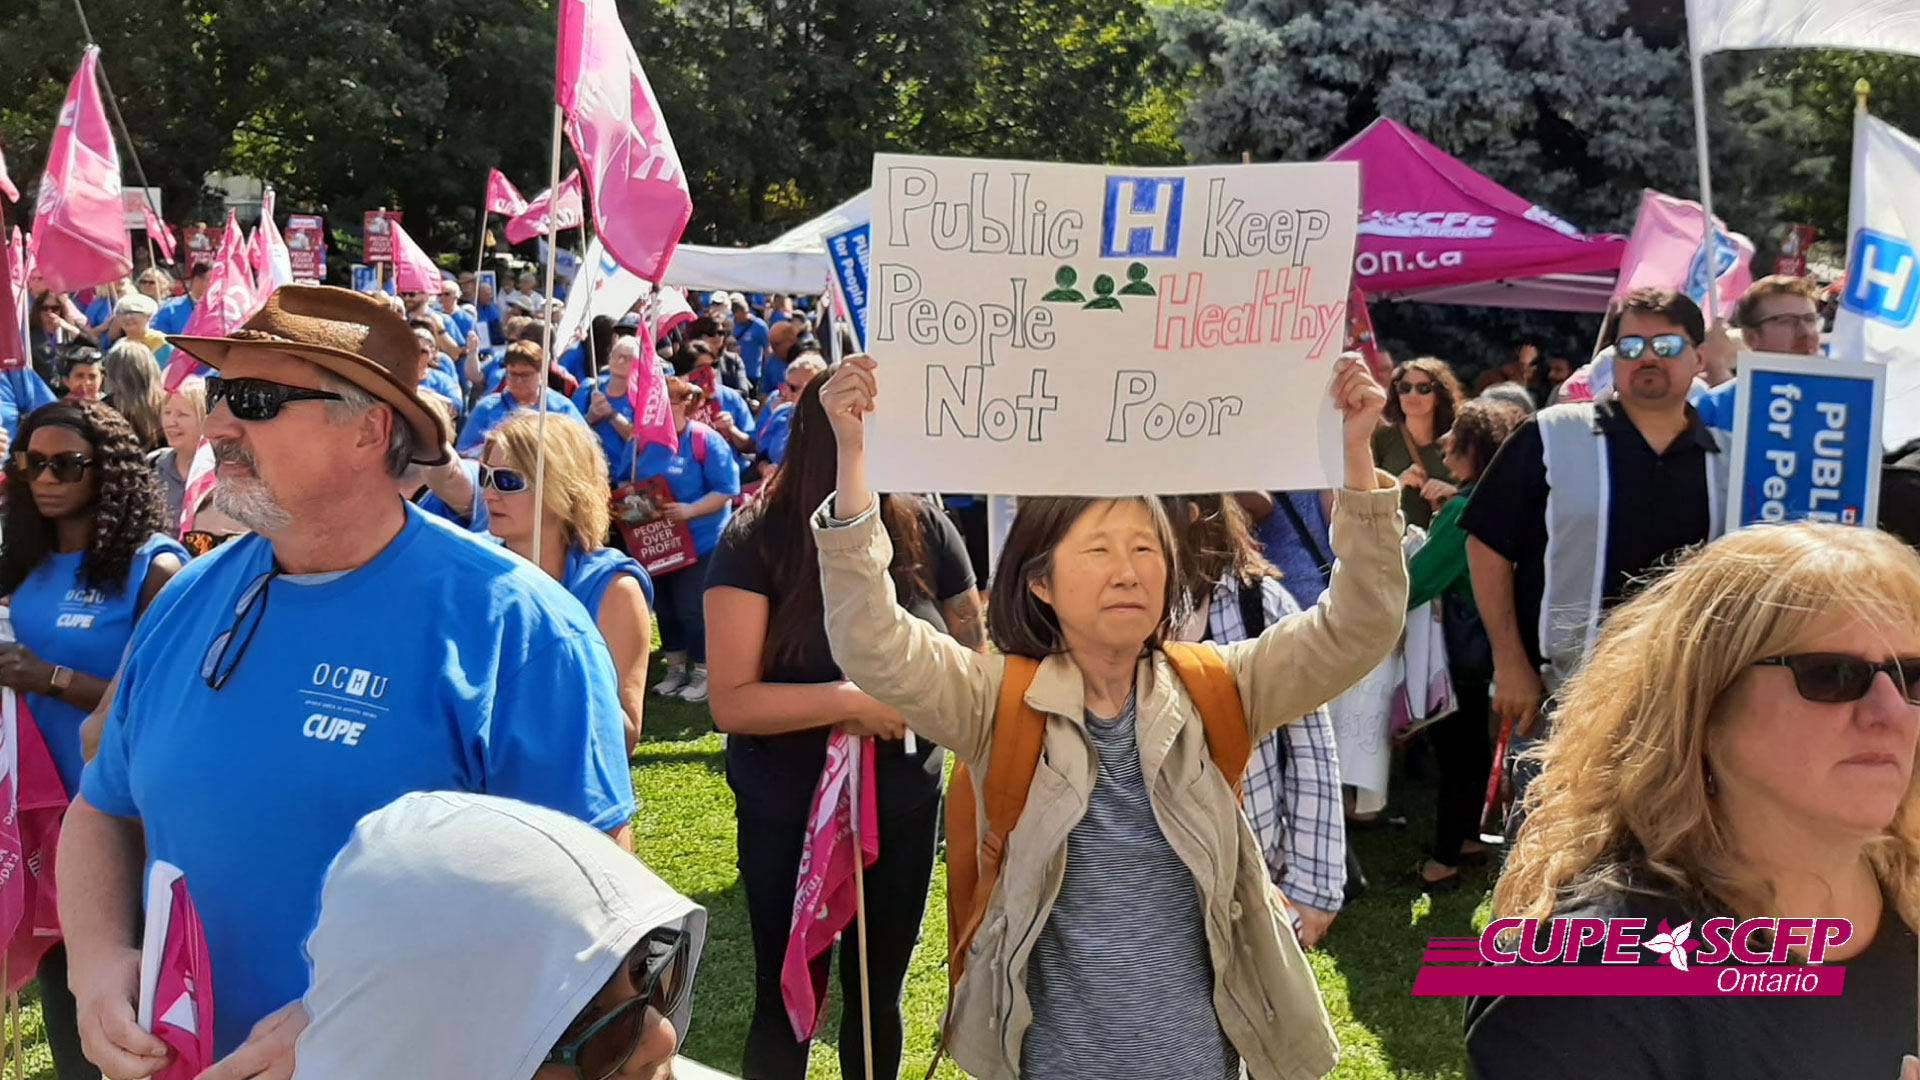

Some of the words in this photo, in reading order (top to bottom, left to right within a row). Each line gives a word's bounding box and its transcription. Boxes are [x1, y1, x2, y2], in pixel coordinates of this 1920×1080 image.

[888, 166, 1083, 259] Public
[1111, 179, 1173, 254] H
[833, 236, 848, 257] for
[840, 257, 865, 306] People
[1854, 243, 1915, 312] H
[876, 262, 1057, 367] People
[1153, 265, 1347, 361] Healthy
[924, 364, 1059, 443] Not
[1104, 369, 1244, 443] Poor
[1767, 383, 1803, 440] for
[1807, 401, 1849, 523] PUBLI
[633, 518, 676, 539] PEOPLE
[640, 536, 683, 559] PROFIT
[642, 529, 674, 546] OVER
[56, 613, 96, 629] CUPE
[312, 662, 389, 699] OCHU
[302, 713, 367, 746] CUPE
